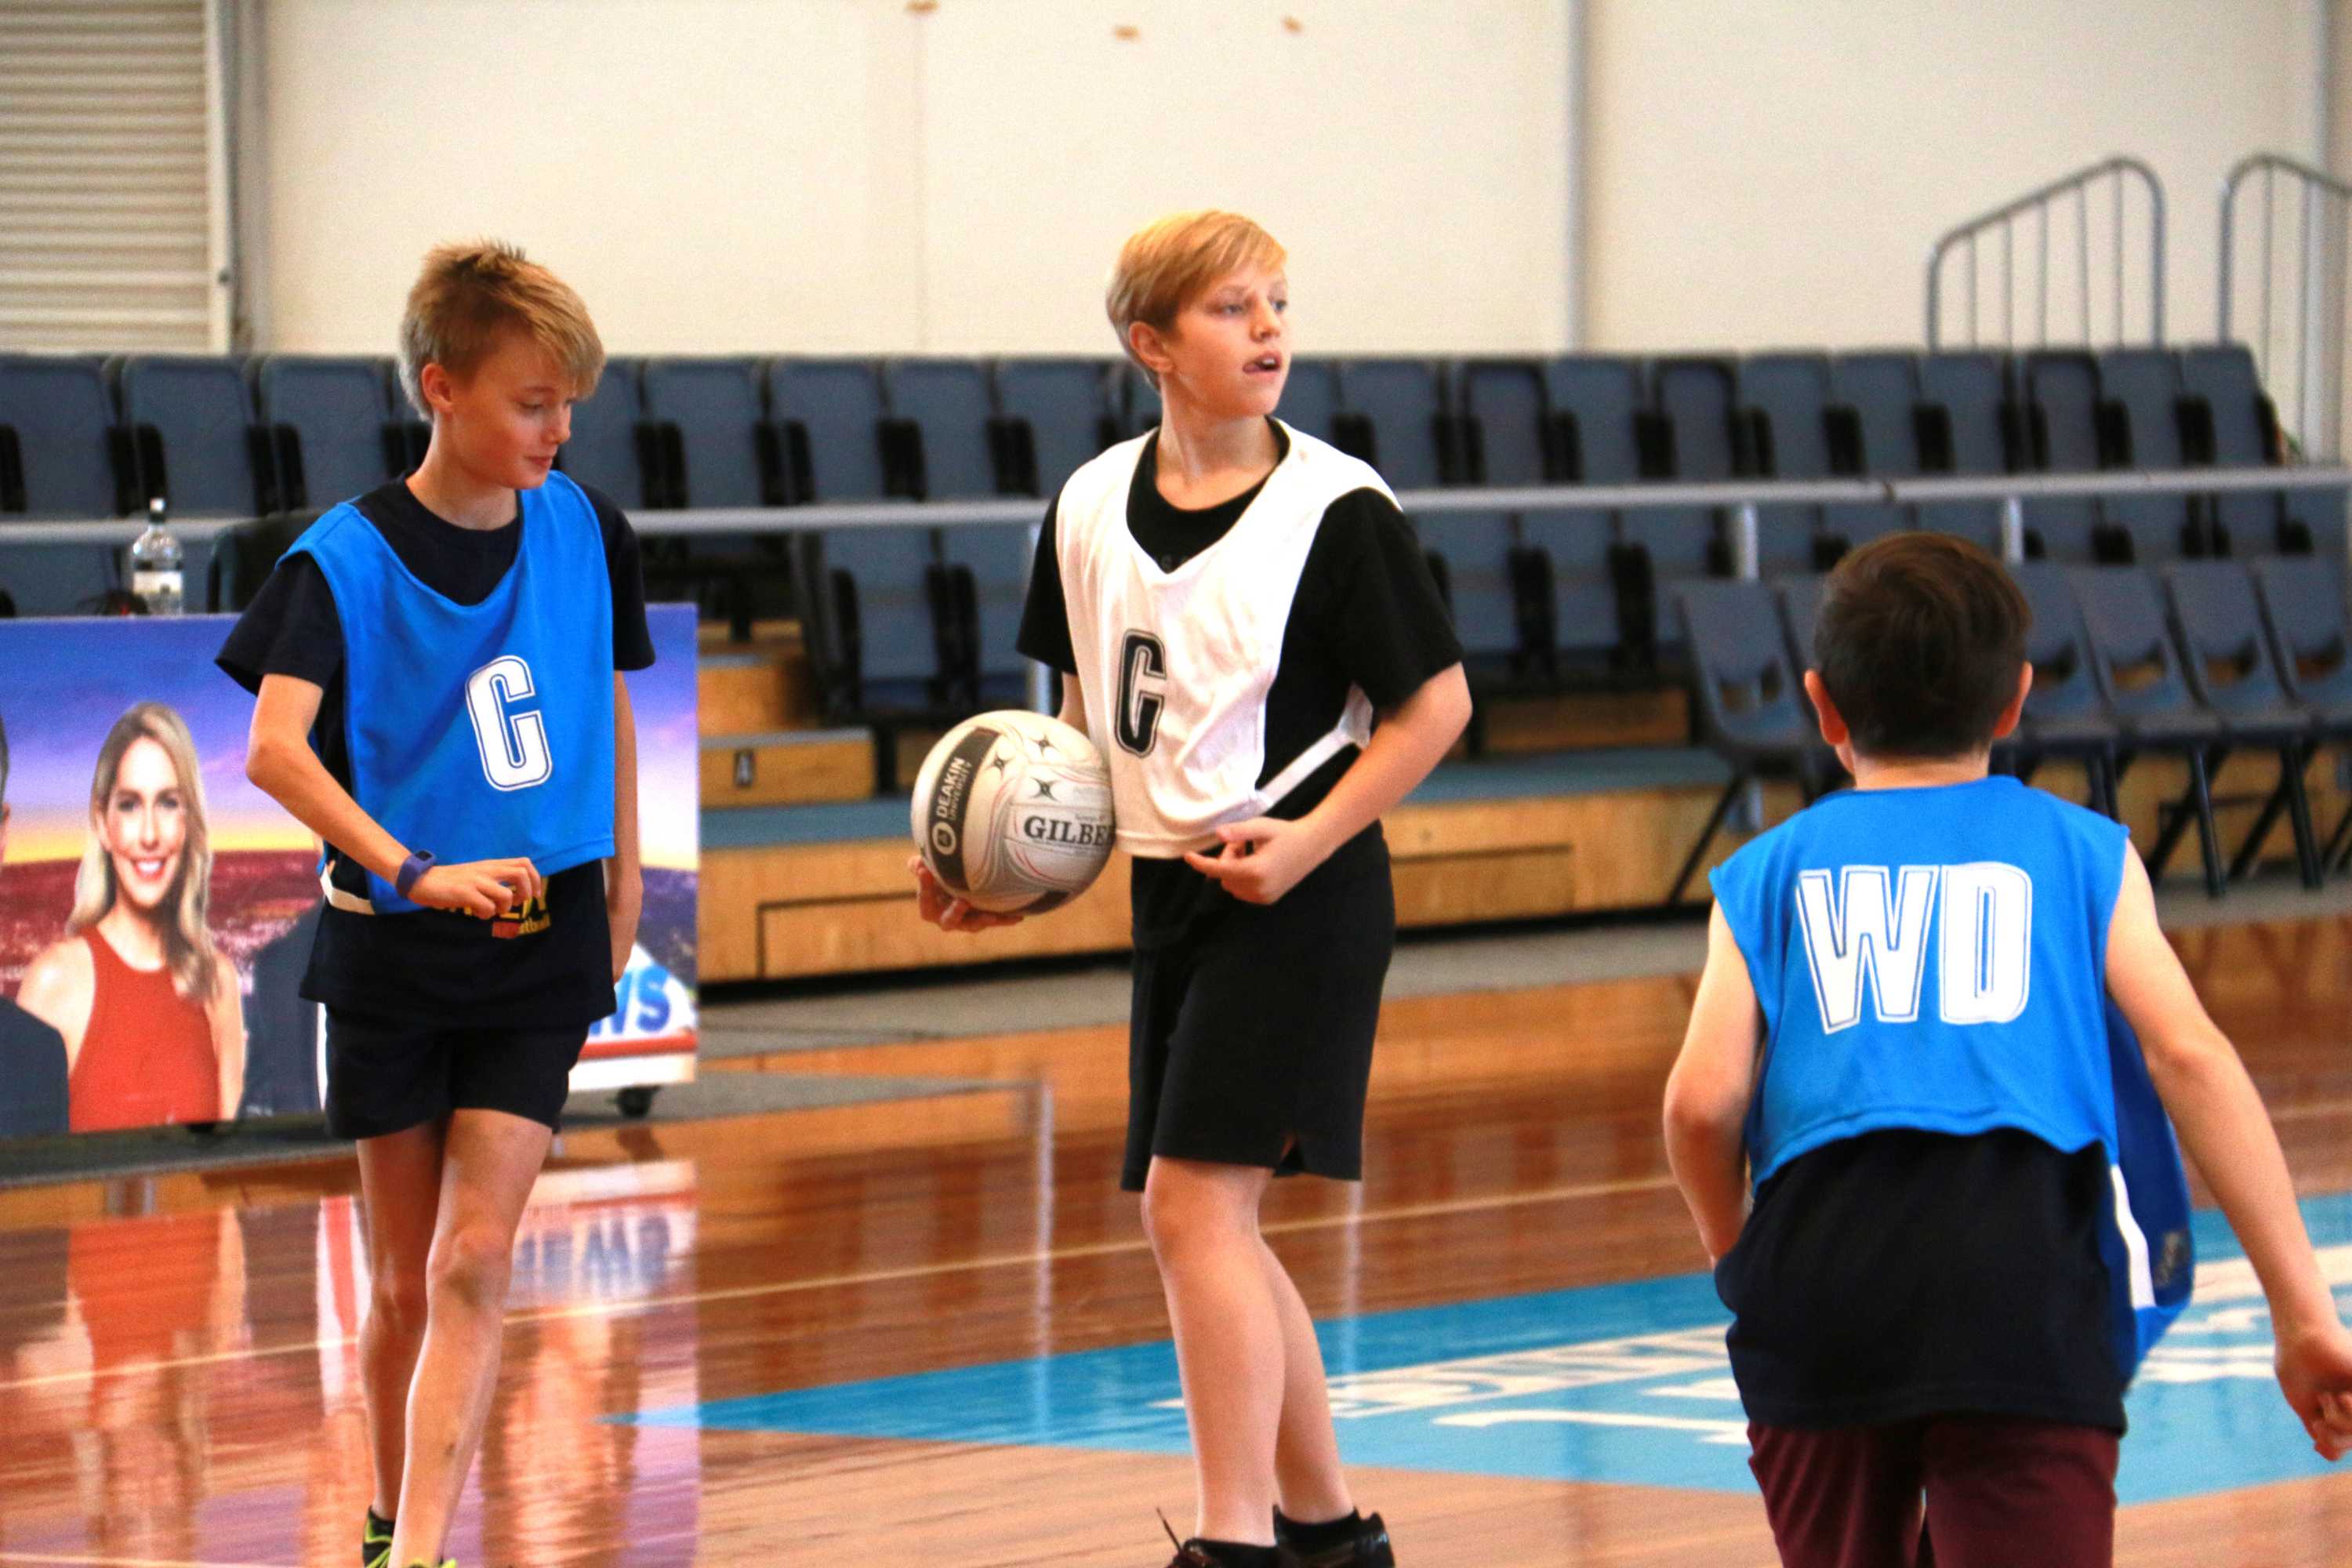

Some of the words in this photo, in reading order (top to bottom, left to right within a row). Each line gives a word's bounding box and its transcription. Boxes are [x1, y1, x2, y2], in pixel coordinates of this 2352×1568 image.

[465, 655, 553, 792] C
[1115, 629, 1167, 758] C
[936, 757, 966, 818] DEAKIN
[1795, 862, 2033, 1035] WD
